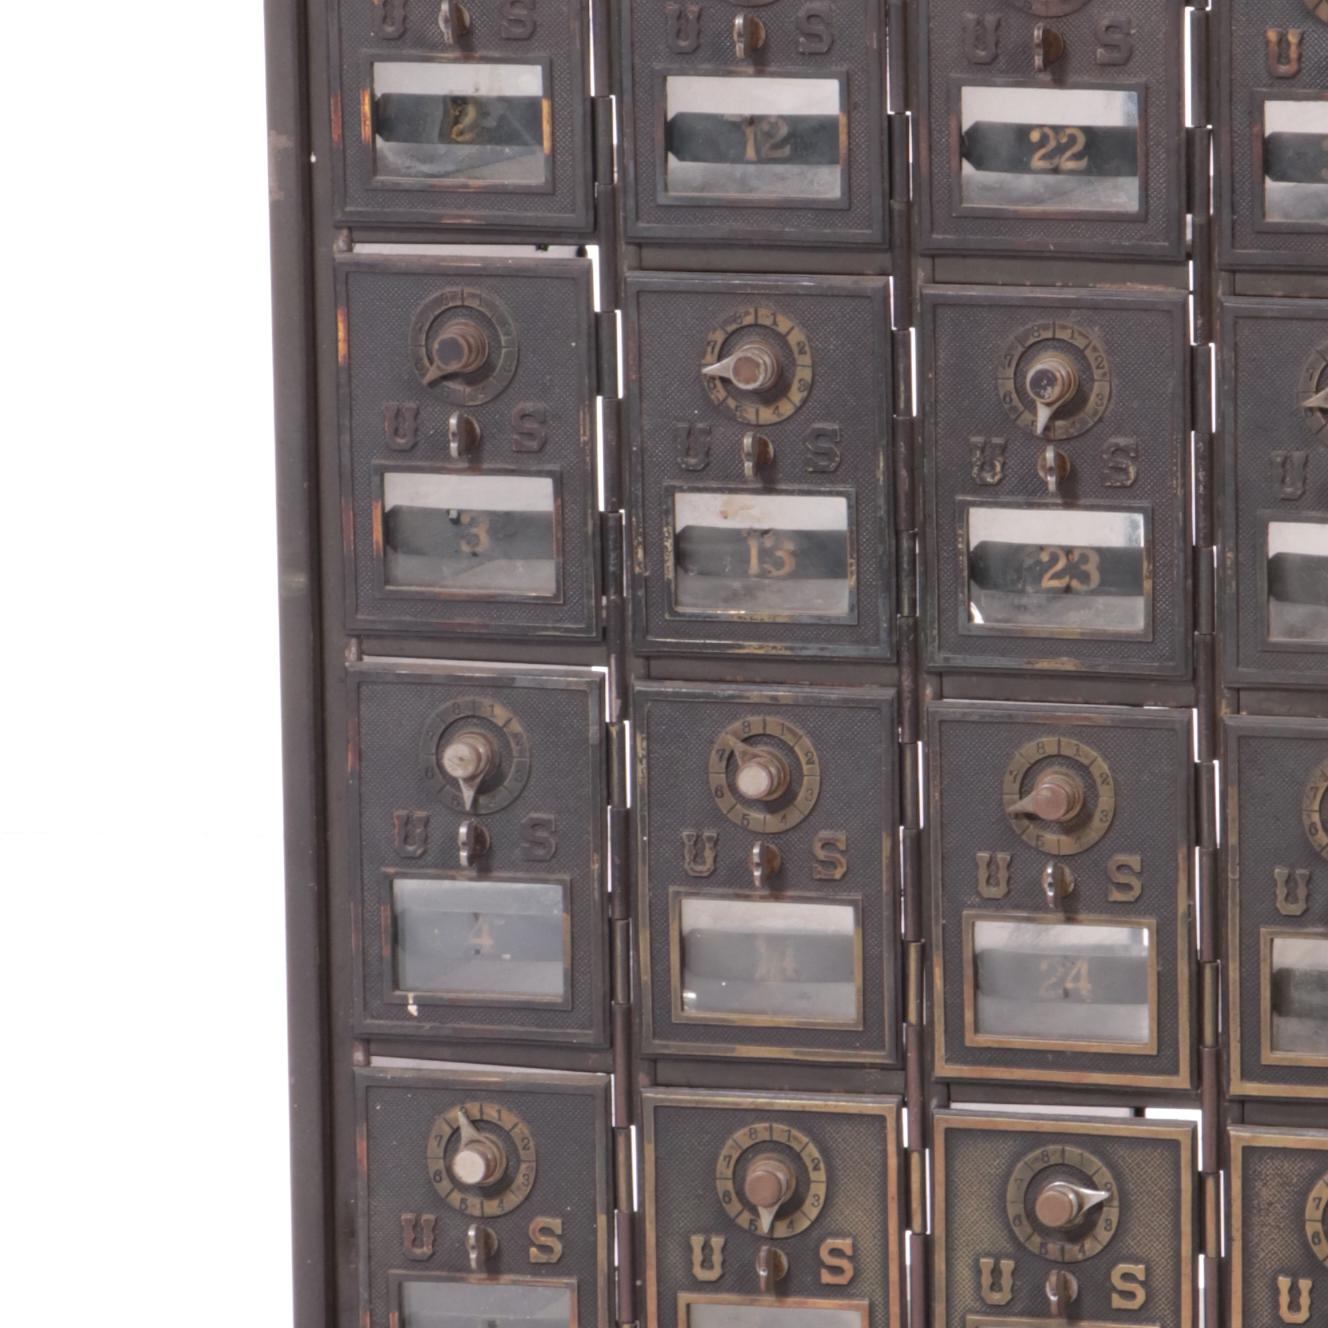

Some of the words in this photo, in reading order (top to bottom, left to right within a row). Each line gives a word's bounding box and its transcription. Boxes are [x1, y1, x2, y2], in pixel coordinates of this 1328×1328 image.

[665, 4, 702, 54] U
[796, 0, 833, 54] S
[962, 11, 1003, 64] U
[1095, 14, 1133, 64] S
[1265, 27, 1304, 78] U
[451, 103, 476, 141] 2
[743, 117, 790, 161] 12
[1029, 127, 1088, 171] 22
[384, 400, 421, 451] U
[511, 401, 547, 453] S
[672, 421, 713, 470] U
[803, 422, 841, 473] S
[969, 436, 1007, 486] U
[1103, 435, 1137, 487] S
[1271, 450, 1309, 500] U
[460, 512, 489, 552] 3
[748, 534, 795, 576] 13
[1040, 546, 1100, 591] 23
[393, 810, 430, 858] U
[519, 813, 558, 860] S
[681, 829, 718, 877] U
[812, 830, 847, 881] S
[975, 851, 1011, 898] U
[1108, 854, 1141, 902] S
[1273, 867, 1310, 916] U
[469, 916, 495, 954] 4
[1040, 958, 1092, 1002] 24
[401, 1212, 438, 1261] U
[529, 1217, 563, 1263] S
[690, 1235, 726, 1283] U
[819, 1237, 854, 1286] S
[980, 1258, 1016, 1305] U
[1110, 1263, 1146, 1310] S
[1277, 1274, 1313, 1325] U
